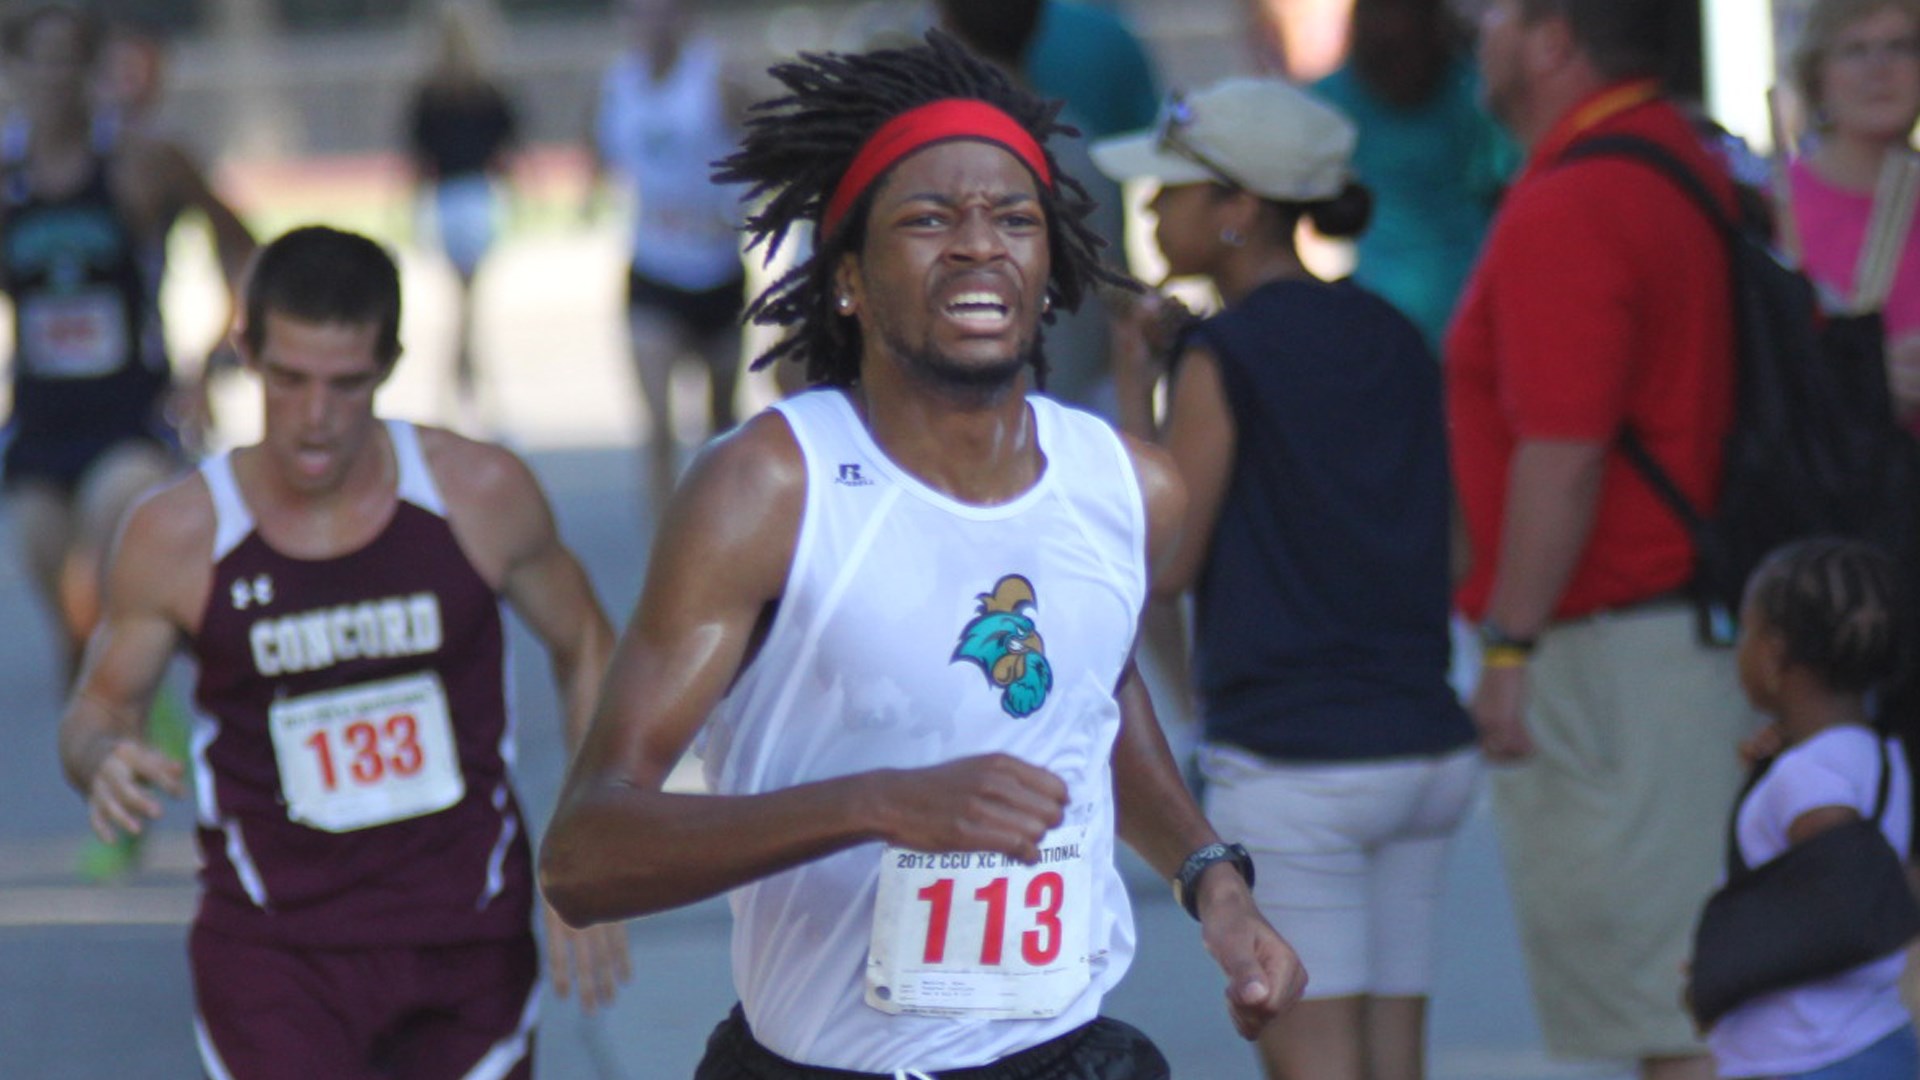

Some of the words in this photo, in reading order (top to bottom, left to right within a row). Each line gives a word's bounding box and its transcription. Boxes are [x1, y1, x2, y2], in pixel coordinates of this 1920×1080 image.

[251, 592, 442, 676] CONCORD
[305, 714, 424, 793] 133
[897, 853, 935, 869] 2012
[939, 853, 970, 869] CCU
[976, 853, 997, 868] XC
[917, 871, 1064, 966] 113
